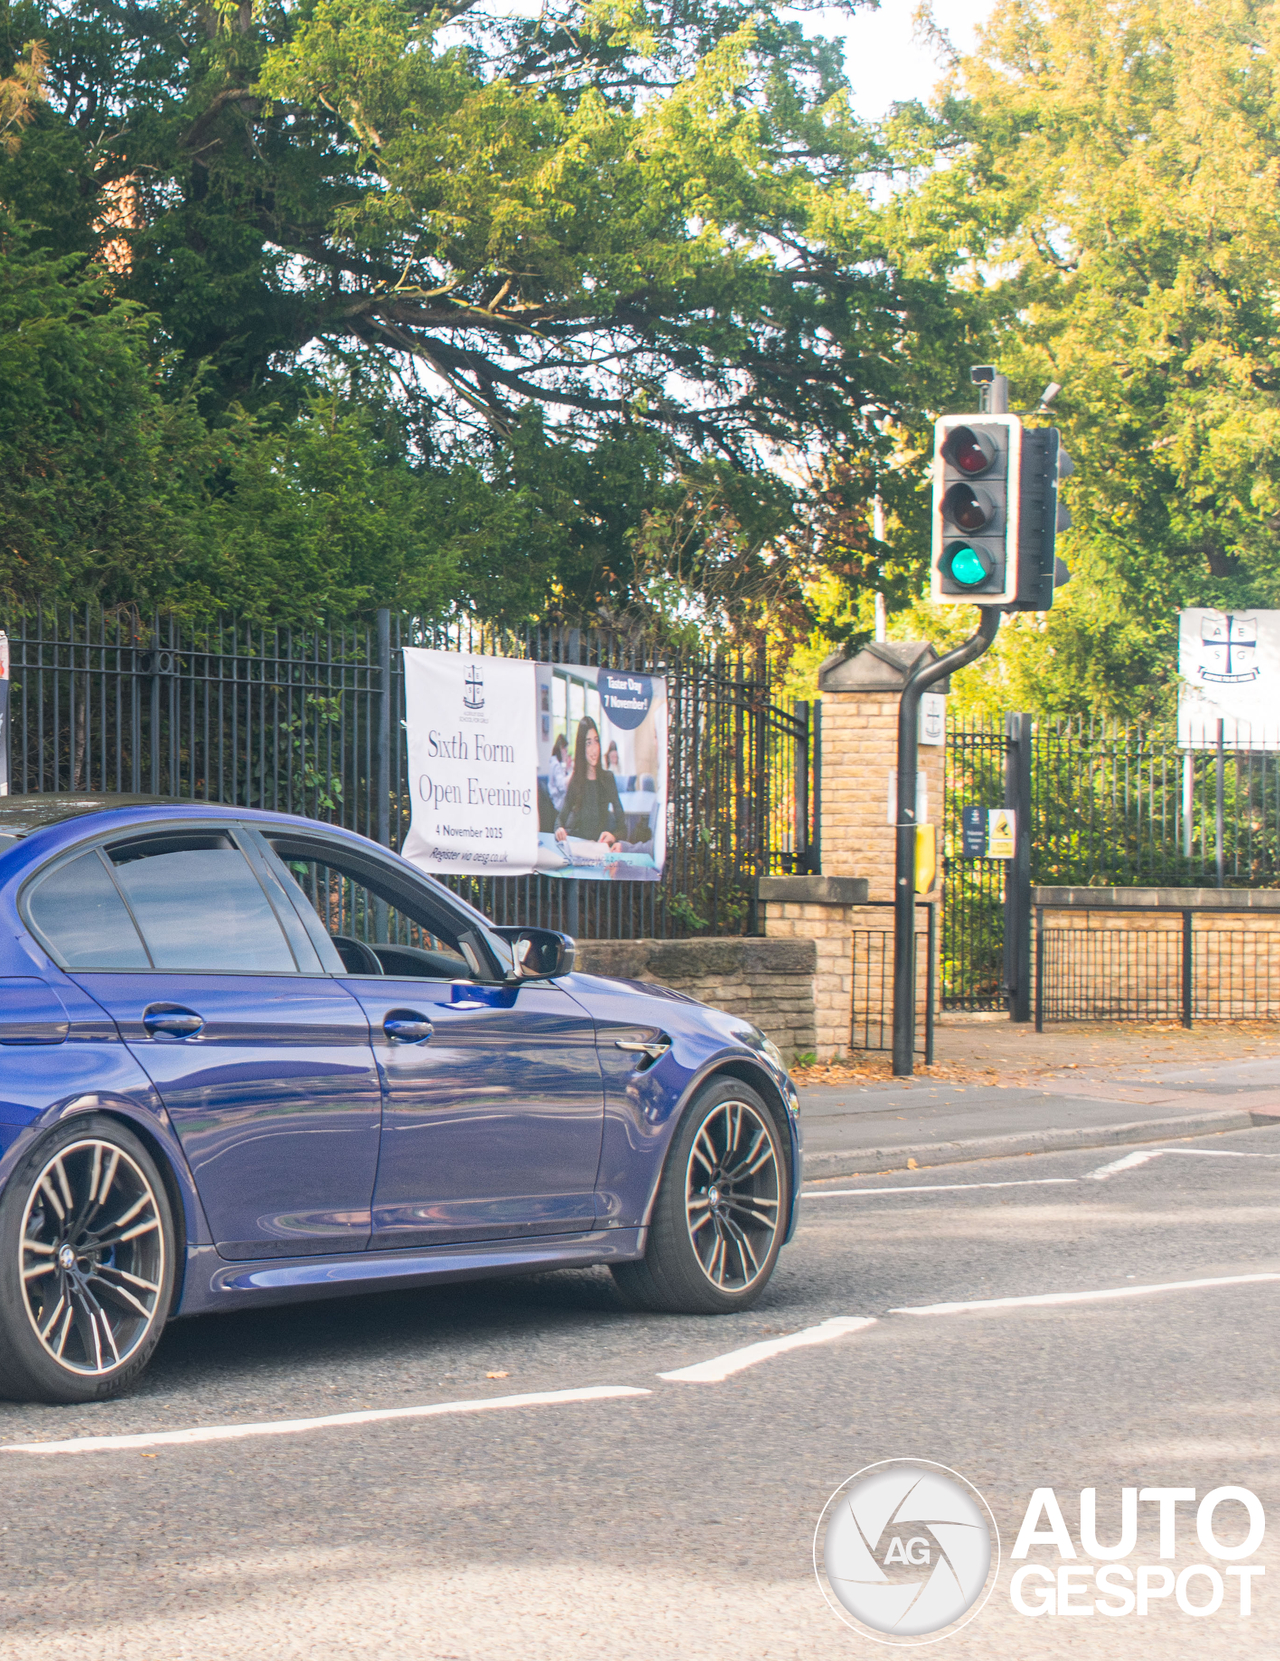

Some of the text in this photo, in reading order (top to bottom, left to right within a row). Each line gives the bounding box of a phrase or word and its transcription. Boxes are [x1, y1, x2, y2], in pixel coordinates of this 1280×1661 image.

[627, 678, 643, 695] Day
[603, 694, 610, 708] 7
[428, 730, 514, 763] Sixth Form
[419, 774, 532, 815] Open Evening
[436, 824, 503, 839] 4 November 2025
[429, 847, 508, 865] Register via aesg.co.uk
